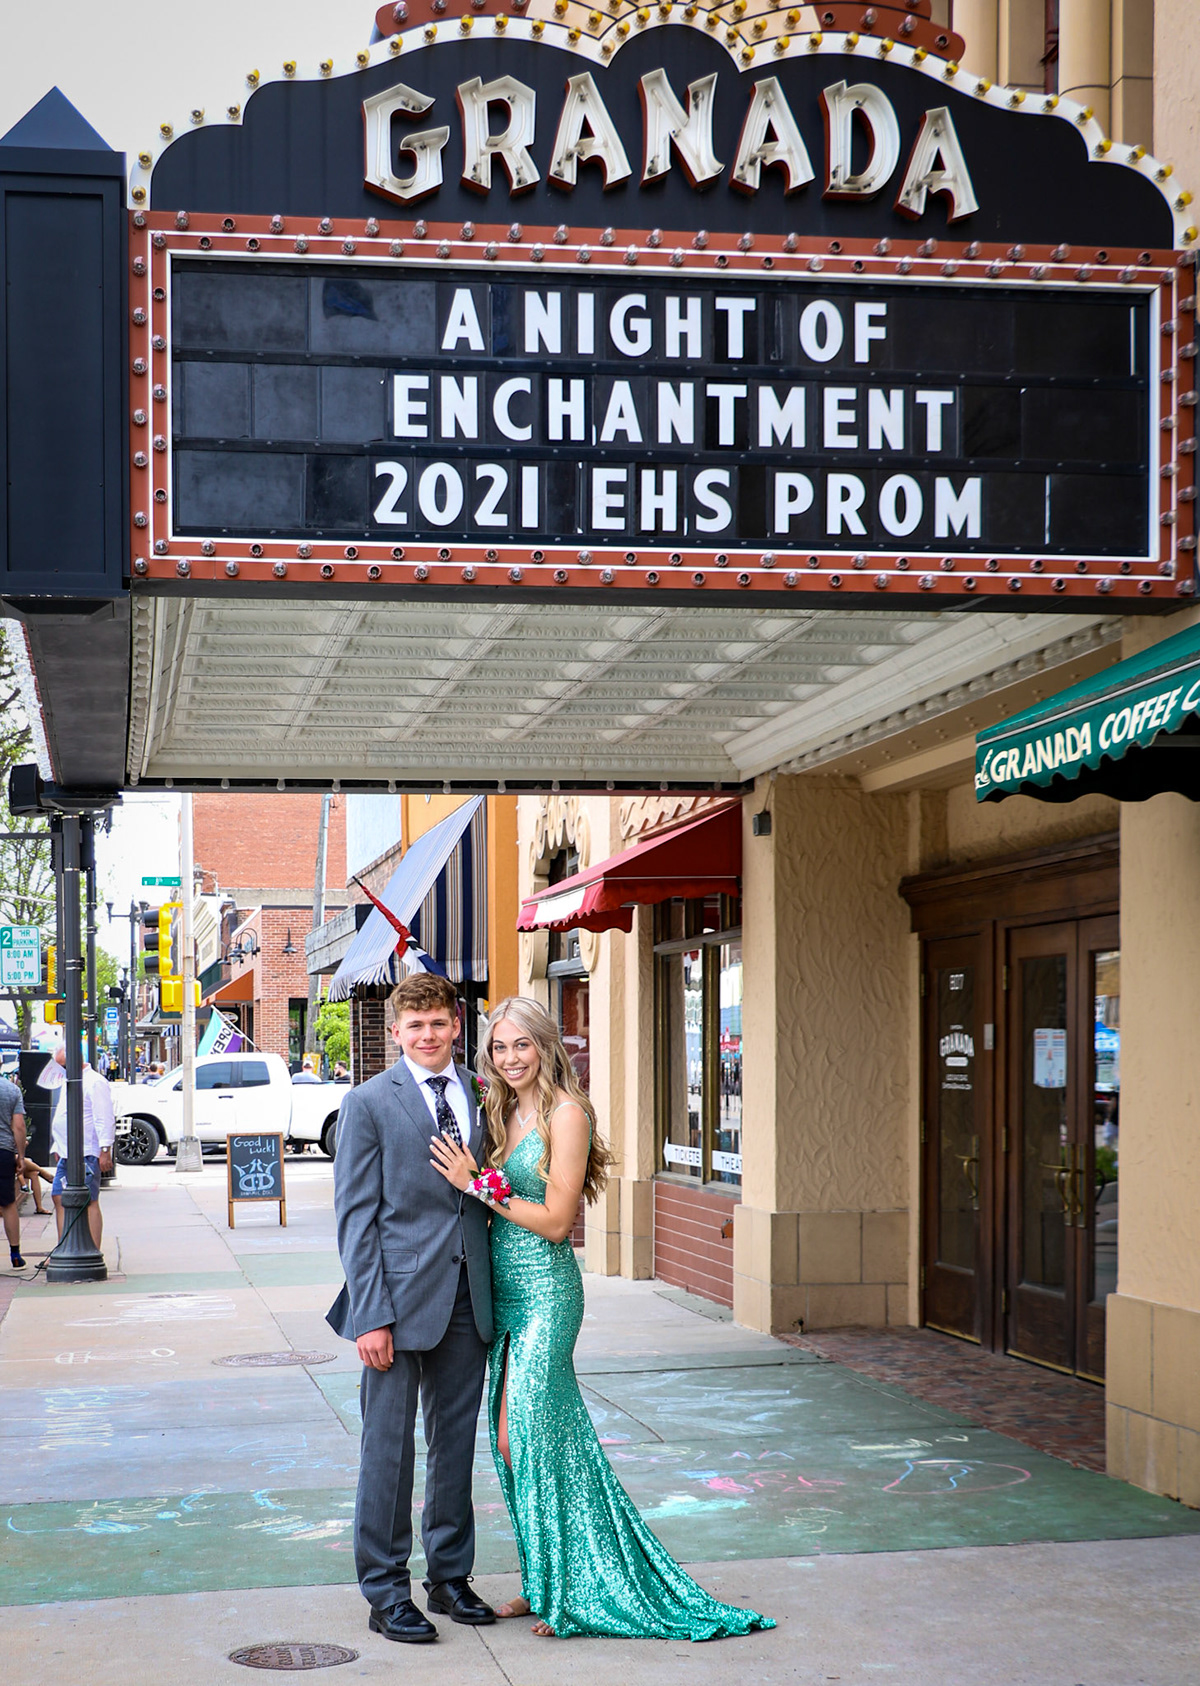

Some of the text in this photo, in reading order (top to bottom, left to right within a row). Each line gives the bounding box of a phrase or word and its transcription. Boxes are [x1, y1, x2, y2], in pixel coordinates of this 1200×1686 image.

[362, 67, 980, 224] GRANADA
[441, 288, 887, 363] A NIGHT OF
[393, 375, 954, 452] ENCHANTMENT
[373, 461, 981, 538] 2021 EHS PROM
[990, 721, 1092, 783] GRANADA
[1099, 685, 1184, 750] COFFEE
[2, 930, 12, 945] 2
[7, 950, 33, 958] 8:00 AM
[16, 961, 25, 969] TO
[7, 971, 34, 980] 5:00 PM
[233, 1136, 262, 1148] Good
[675, 1148, 700, 1164] TICKETS
